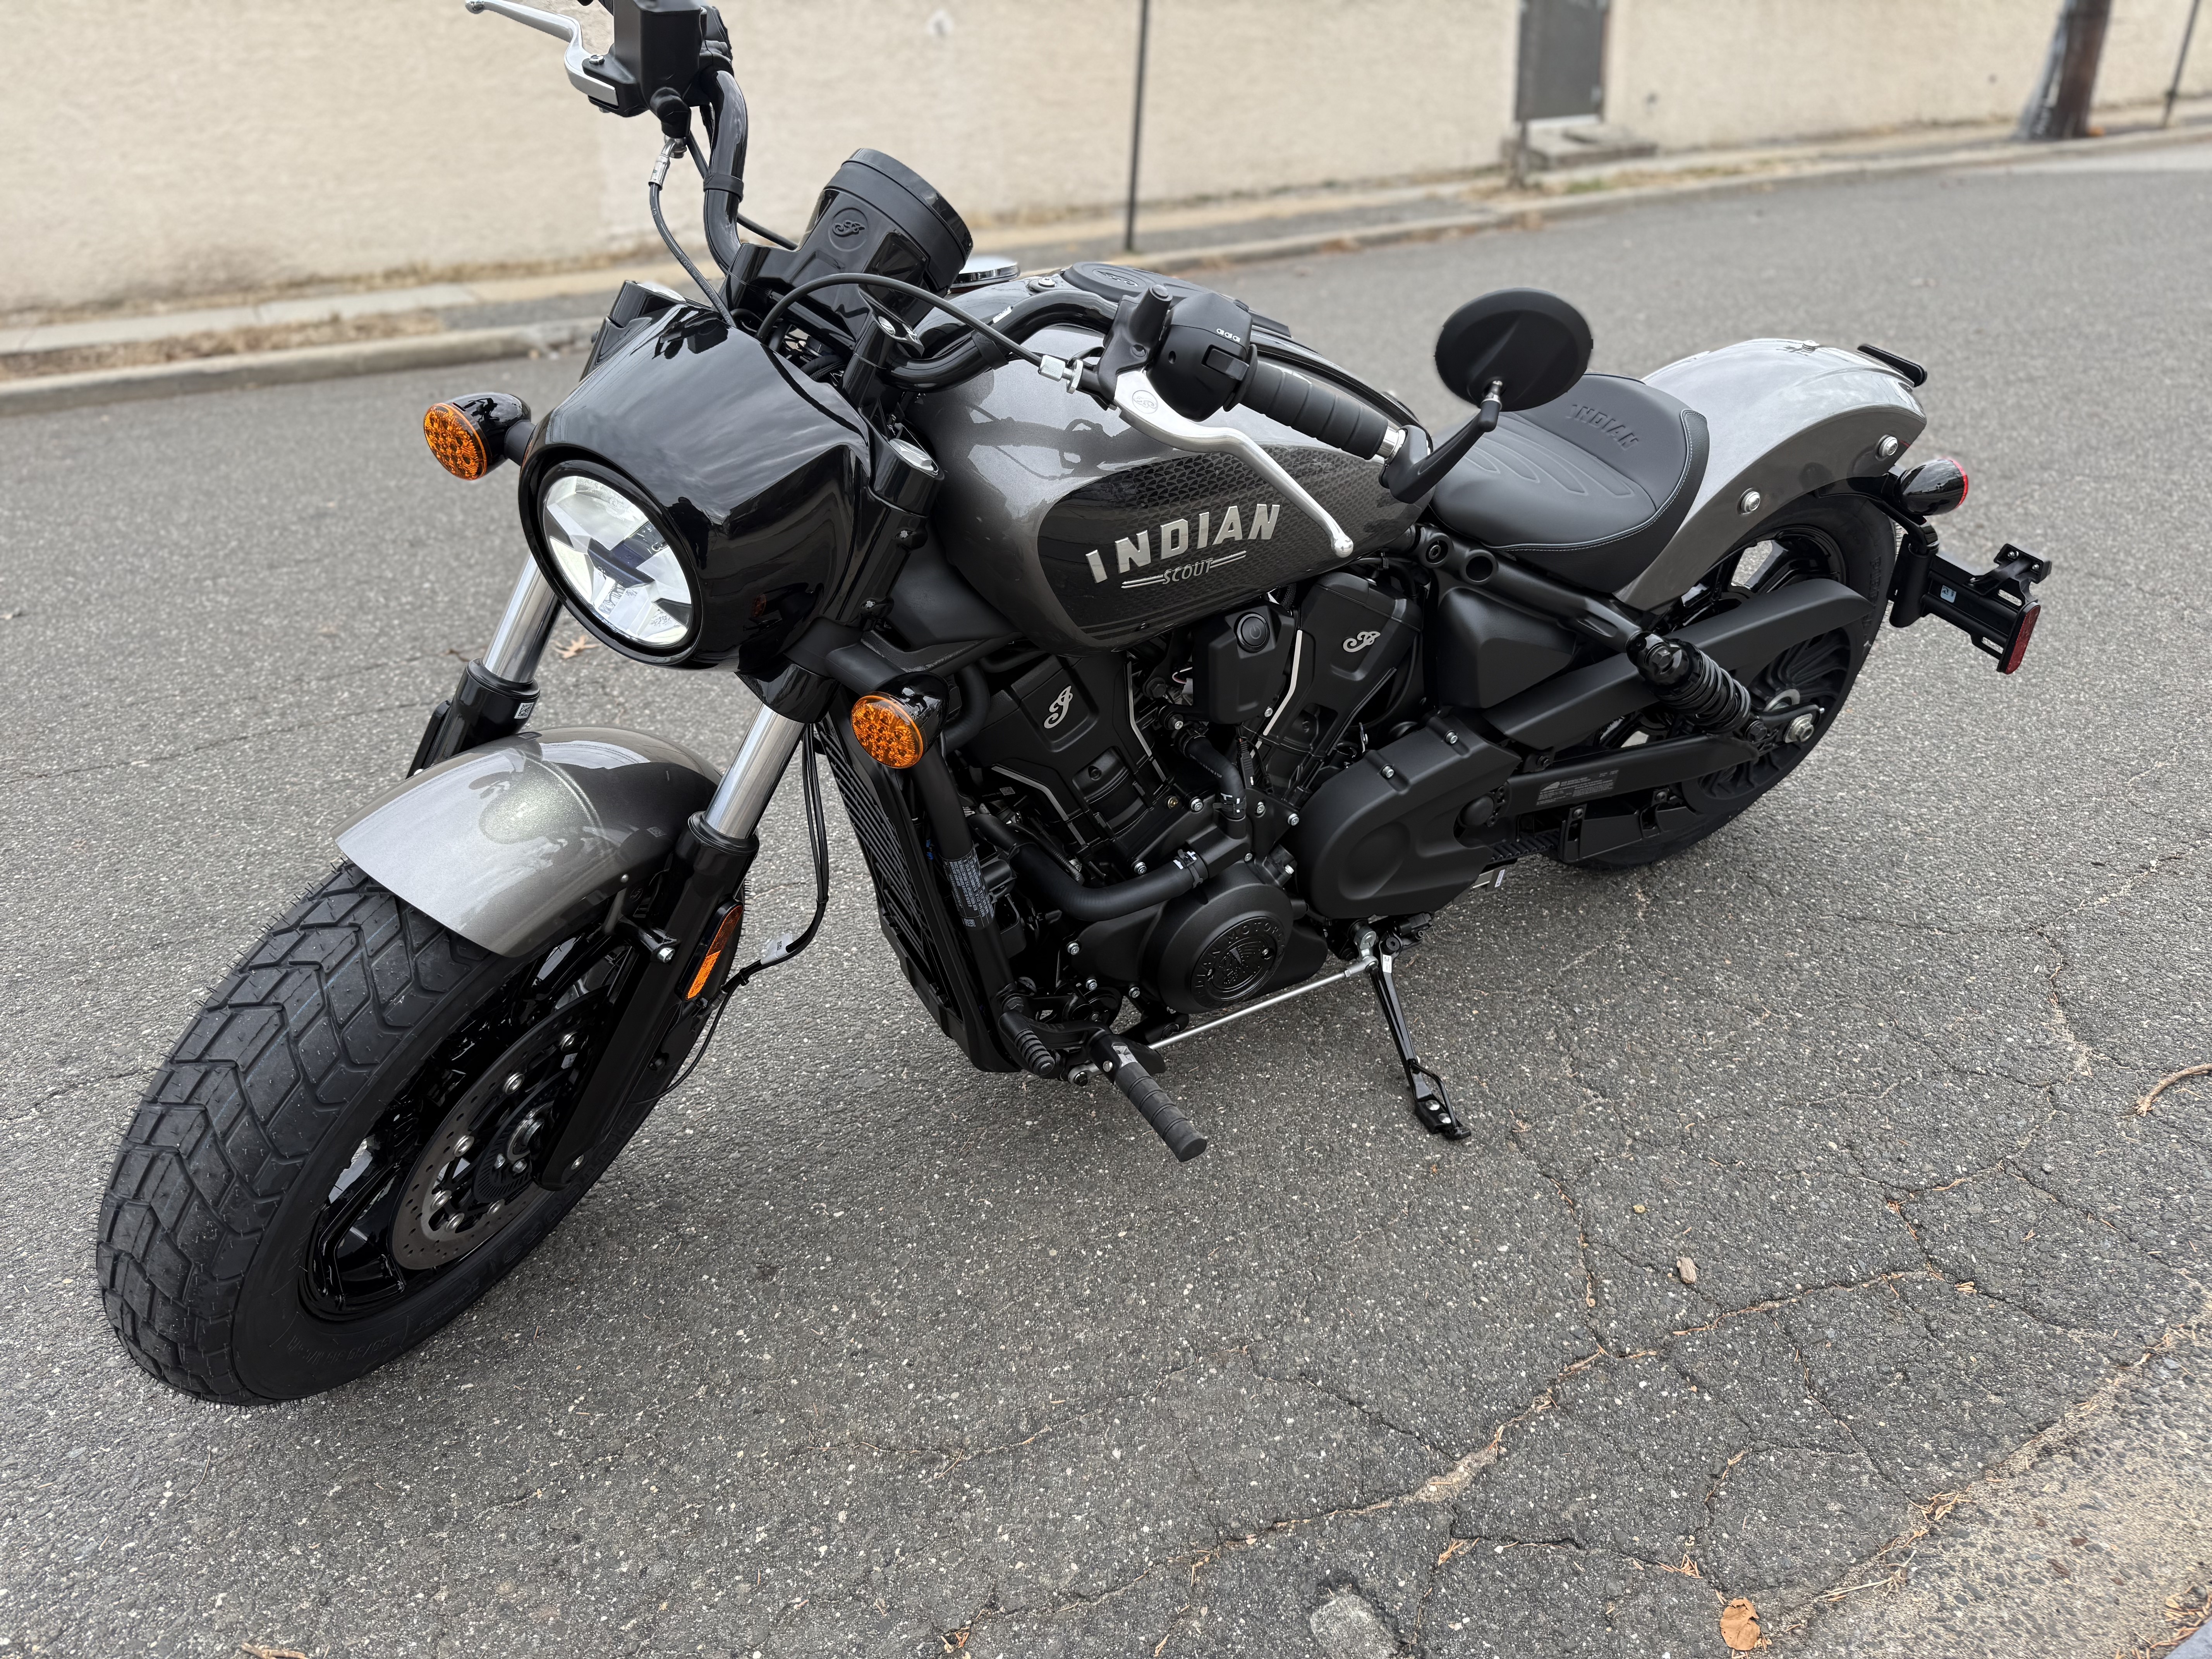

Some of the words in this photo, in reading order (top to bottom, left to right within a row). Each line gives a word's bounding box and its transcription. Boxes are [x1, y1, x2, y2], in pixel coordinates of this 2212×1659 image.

[1566, 404, 1640, 451] INDIAN
[1085, 503, 1280, 584] INDIAN
[1163, 558, 1215, 584] SCOUT
